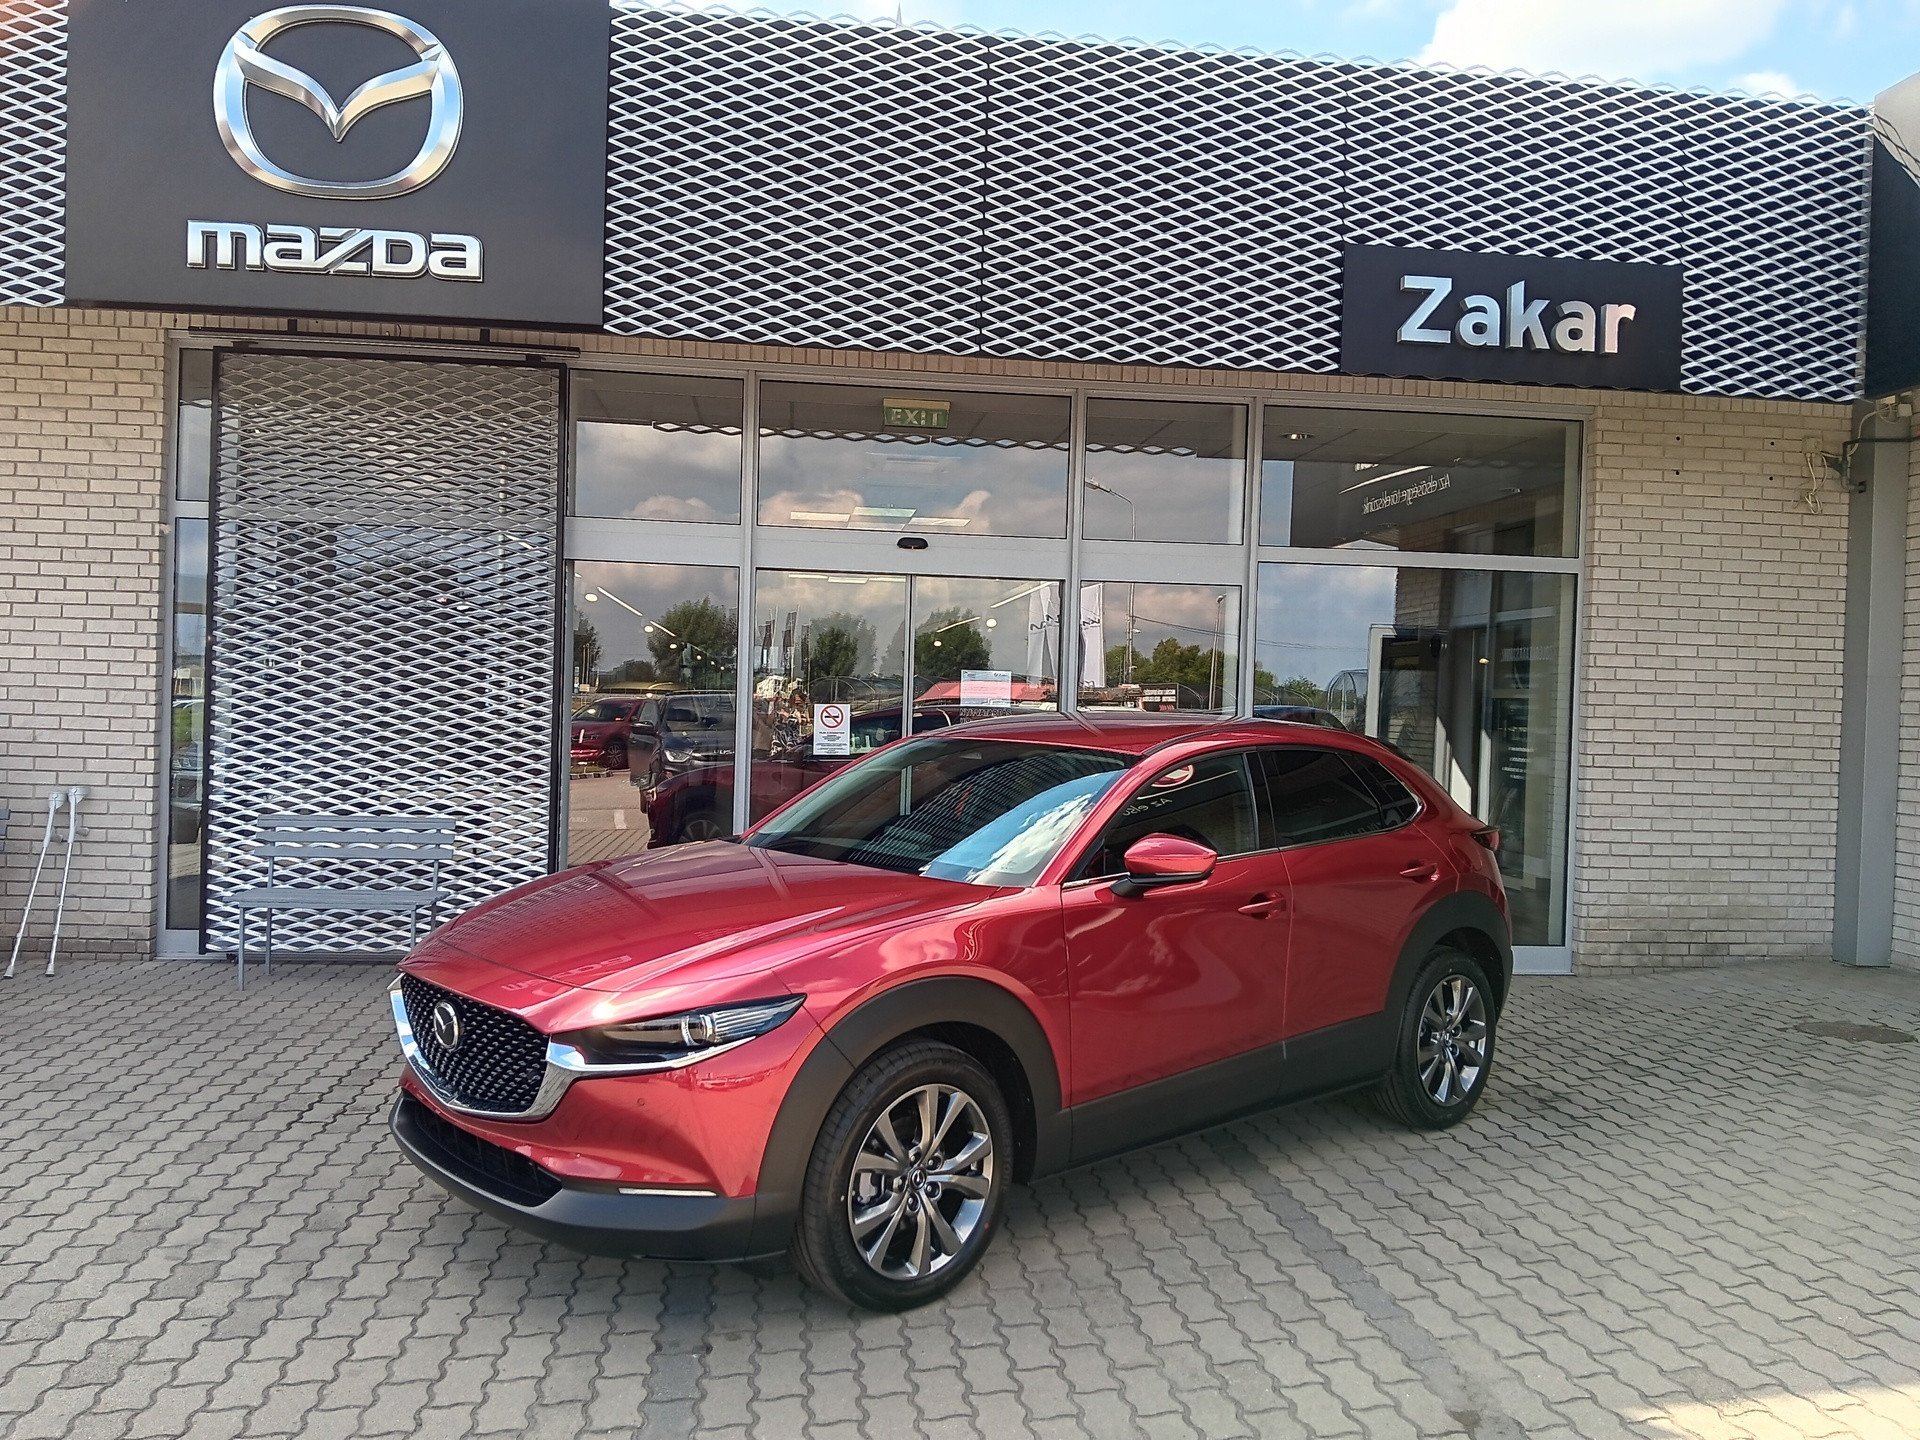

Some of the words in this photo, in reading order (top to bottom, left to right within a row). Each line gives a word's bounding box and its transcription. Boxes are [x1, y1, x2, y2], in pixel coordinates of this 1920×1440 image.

[186, 219, 485, 283] mazda
[1396, 274, 1637, 355] Zakar
[891, 408, 942, 426] EXIT
